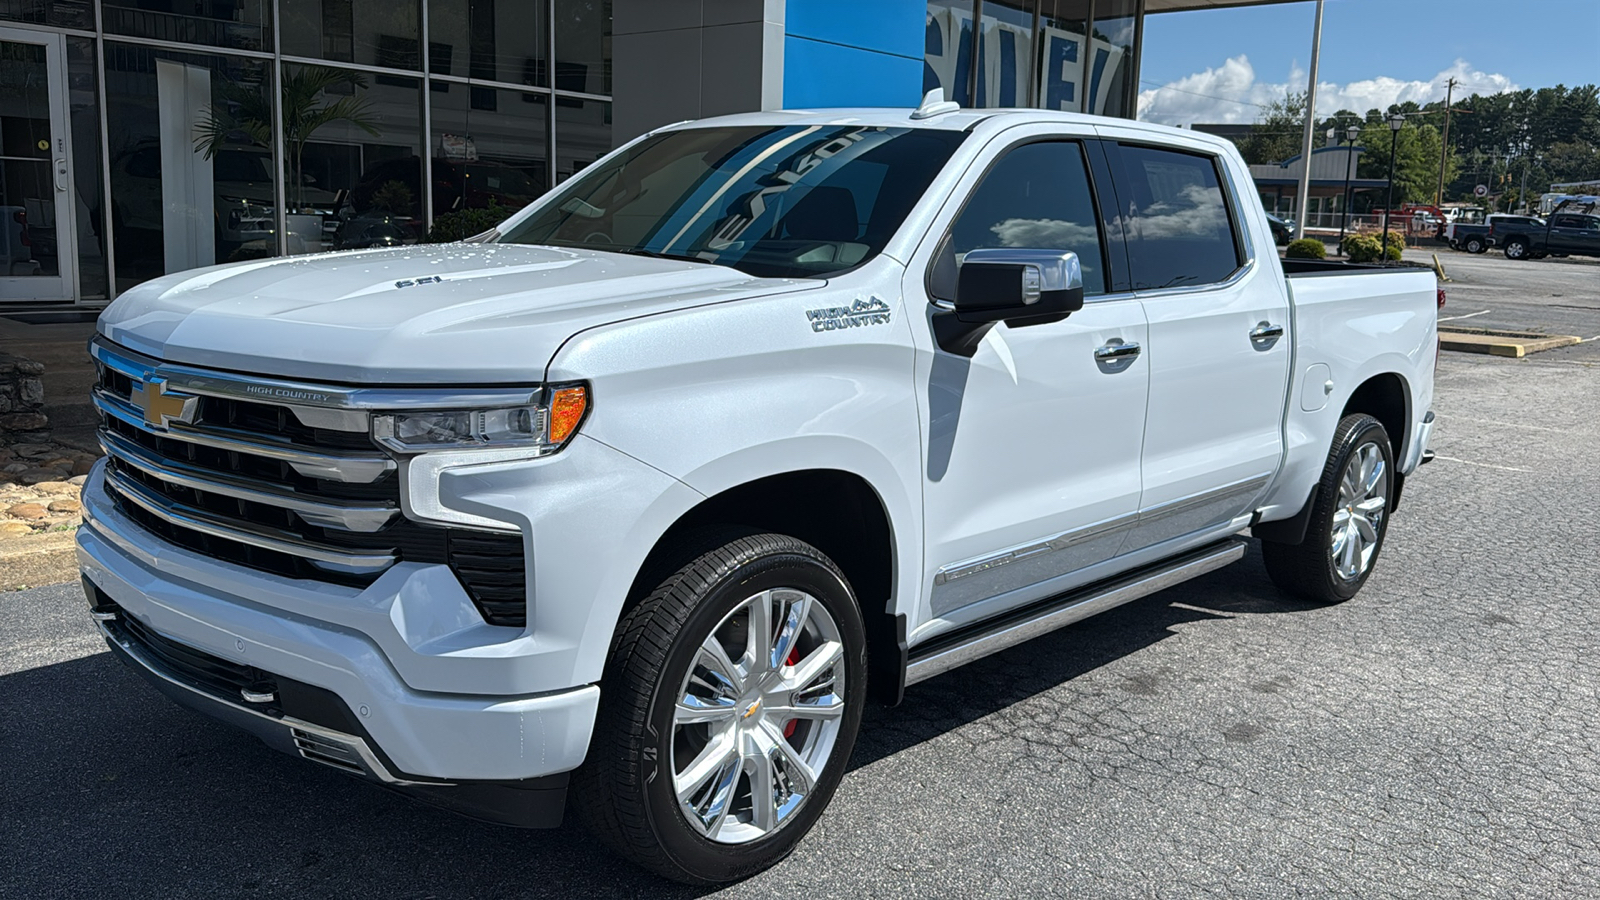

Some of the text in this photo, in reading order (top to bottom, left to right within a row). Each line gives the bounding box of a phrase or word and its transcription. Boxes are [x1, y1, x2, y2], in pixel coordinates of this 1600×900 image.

[806, 306, 853, 321] HIGH
[811, 313, 891, 333] COUNTRY
[246, 385, 331, 401] HIGH COUNTRY
